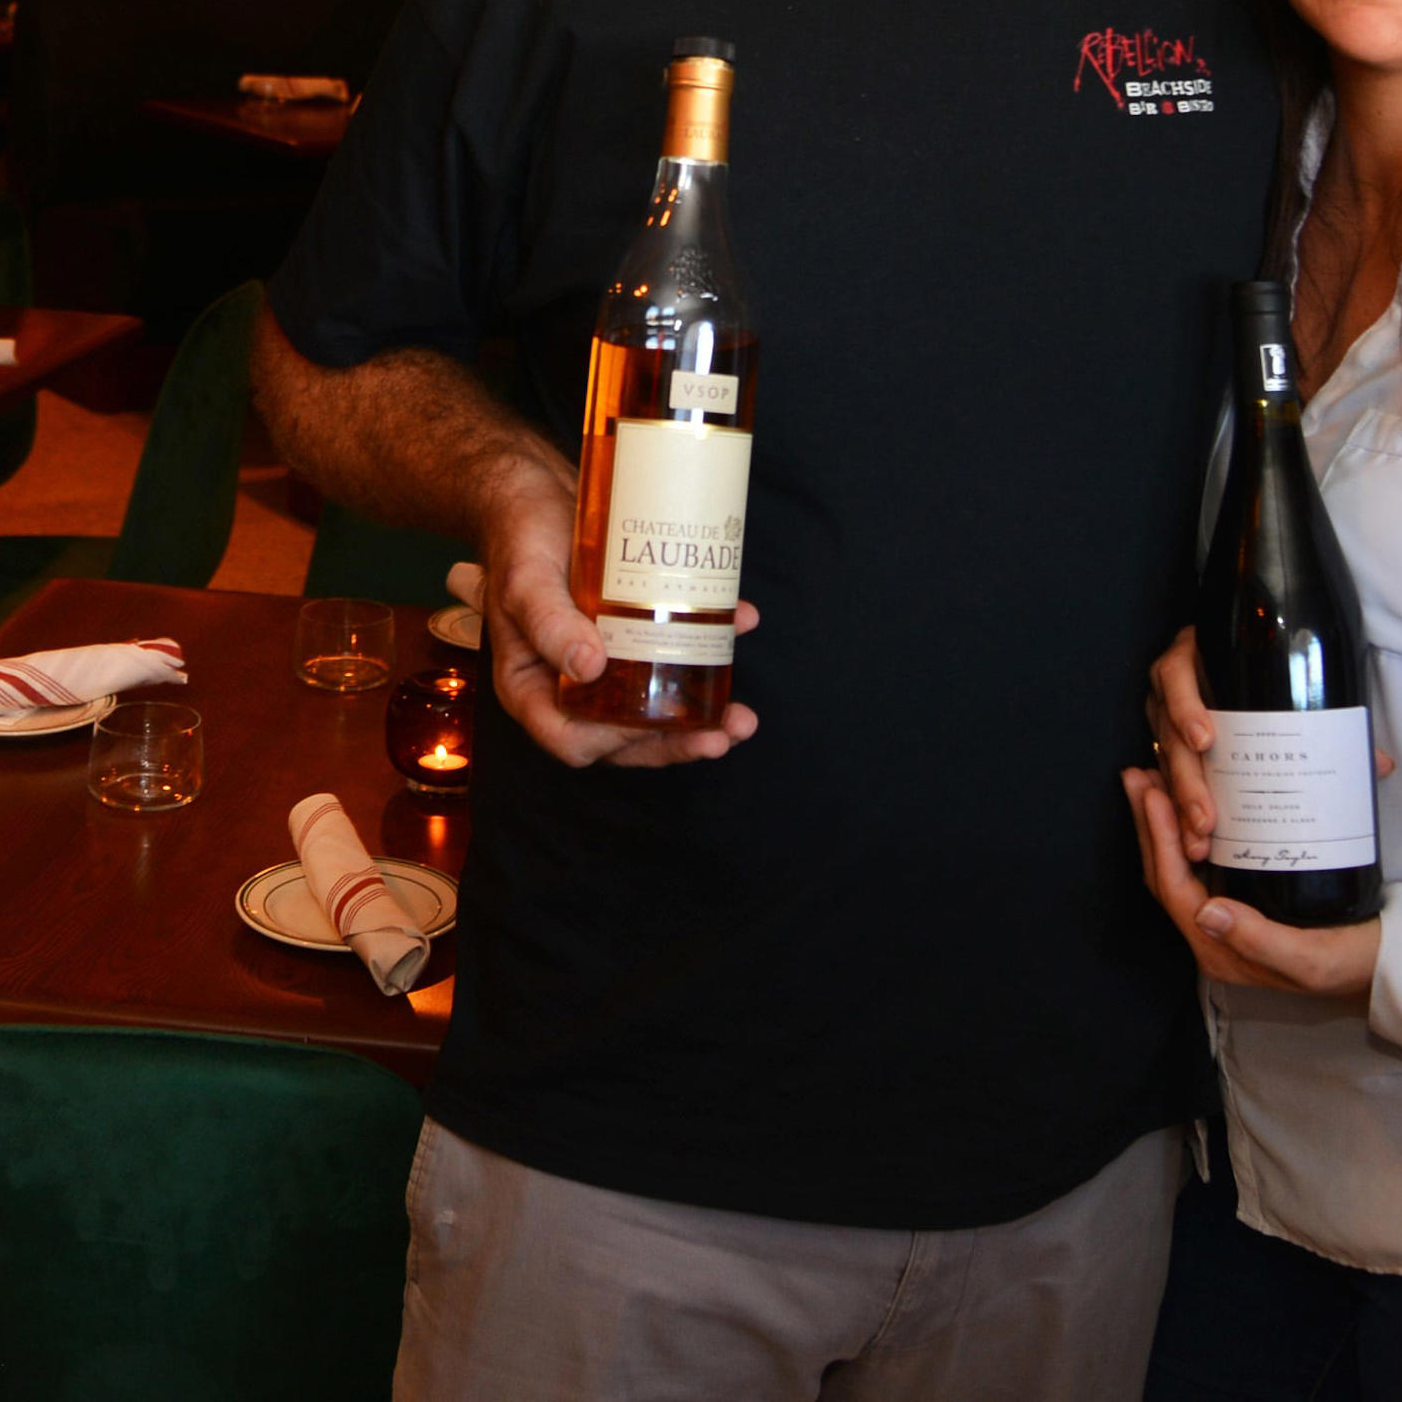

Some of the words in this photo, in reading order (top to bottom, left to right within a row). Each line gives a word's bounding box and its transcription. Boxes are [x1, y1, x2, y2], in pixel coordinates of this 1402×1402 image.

[1125, 79, 1213, 97] BEACHSIDE
[683, 383, 730, 400] VSOP
[621, 518, 699, 539] CHATEAU
[701, 525, 719, 540] DE
[620, 538, 740, 571] LAUBADE
[1231, 752, 1309, 762] CAHORS
